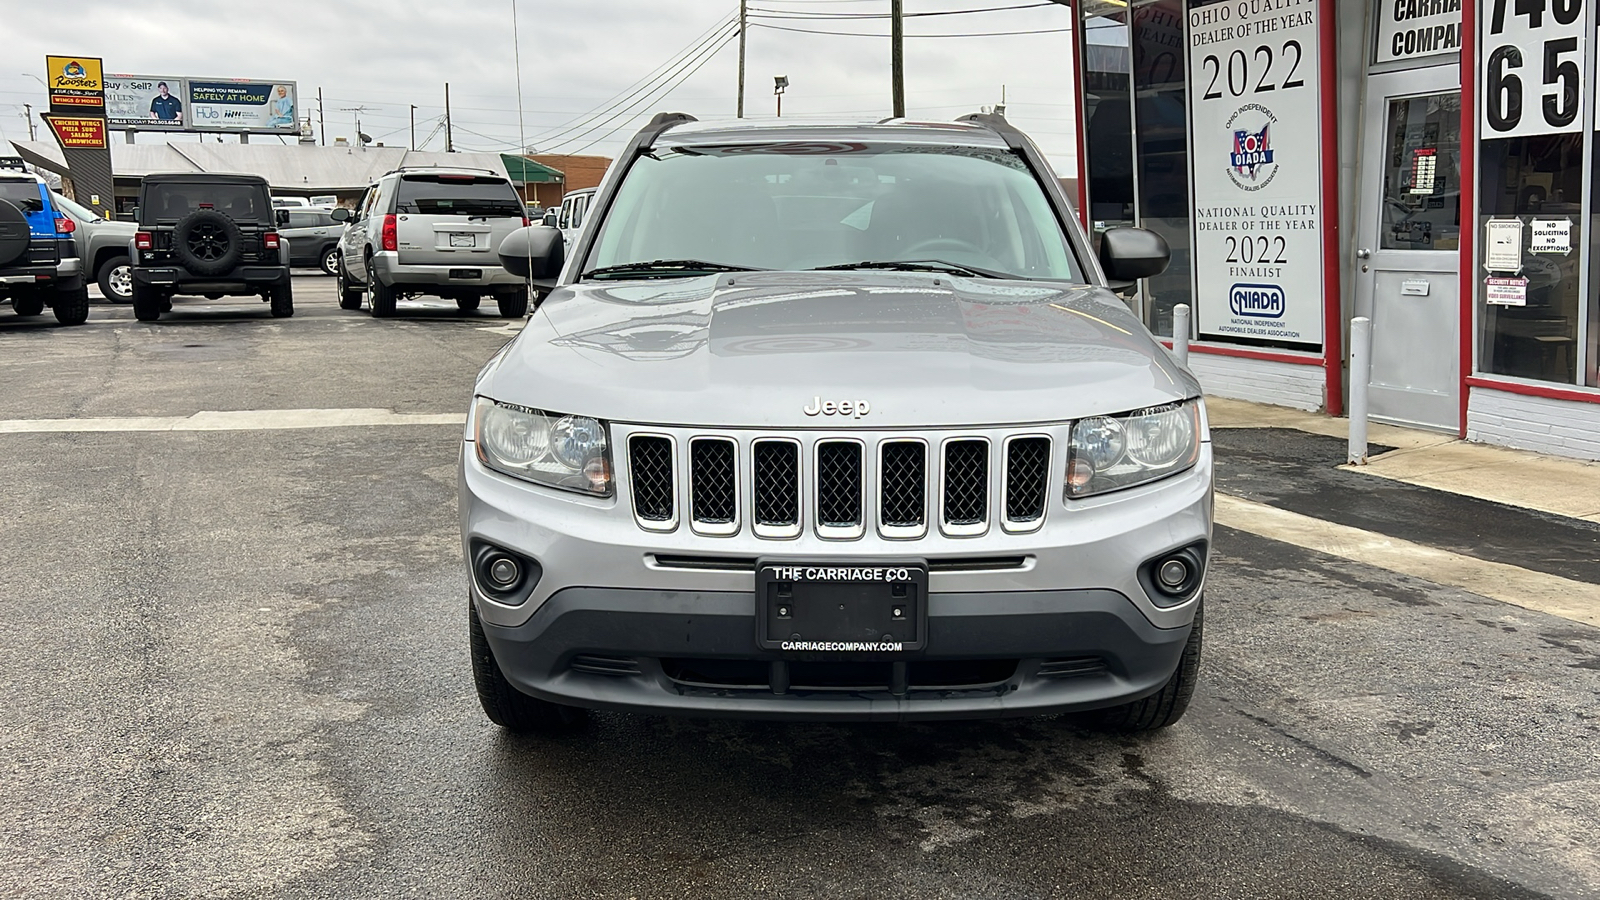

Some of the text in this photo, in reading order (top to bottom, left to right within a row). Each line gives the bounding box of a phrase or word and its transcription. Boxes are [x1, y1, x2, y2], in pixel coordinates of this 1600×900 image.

[1191, 6, 1230, 27] OHIO
[1193, 11, 1313, 47] DEALER OF THE YEAR
[1203, 40, 1304, 100] 2022
[55, 75, 97, 88] Roosters
[131, 82, 152, 90] Sell?
[193, 93, 225, 101] SAFELY
[1225, 103, 1278, 129] OHIO INDEPENDENT
[1235, 152, 1267, 165] OIADA
[1226, 168, 1245, 190] AUTOMOBILE
[1260, 164, 1279, 188] ASSOCIATION
[1198, 204, 1316, 218] NATIONAL QUALITY
[1200, 219, 1316, 231] DEALER OF THE YEAR
[1225, 235, 1288, 264] 2022
[1229, 267, 1281, 278] FINALIST
[1234, 290, 1280, 311] NIADA
[1231, 318, 1286, 328] NATIONAL INDEPENDENT
[1218, 326, 1300, 338] AUTOMOBILE DEALERS ASSOCIATION
[803, 396, 870, 419] Jeep
[773, 568, 912, 581] THE CARRIAGE CO.
[781, 641, 903, 652] CARRIAGECOMPANY.COM
